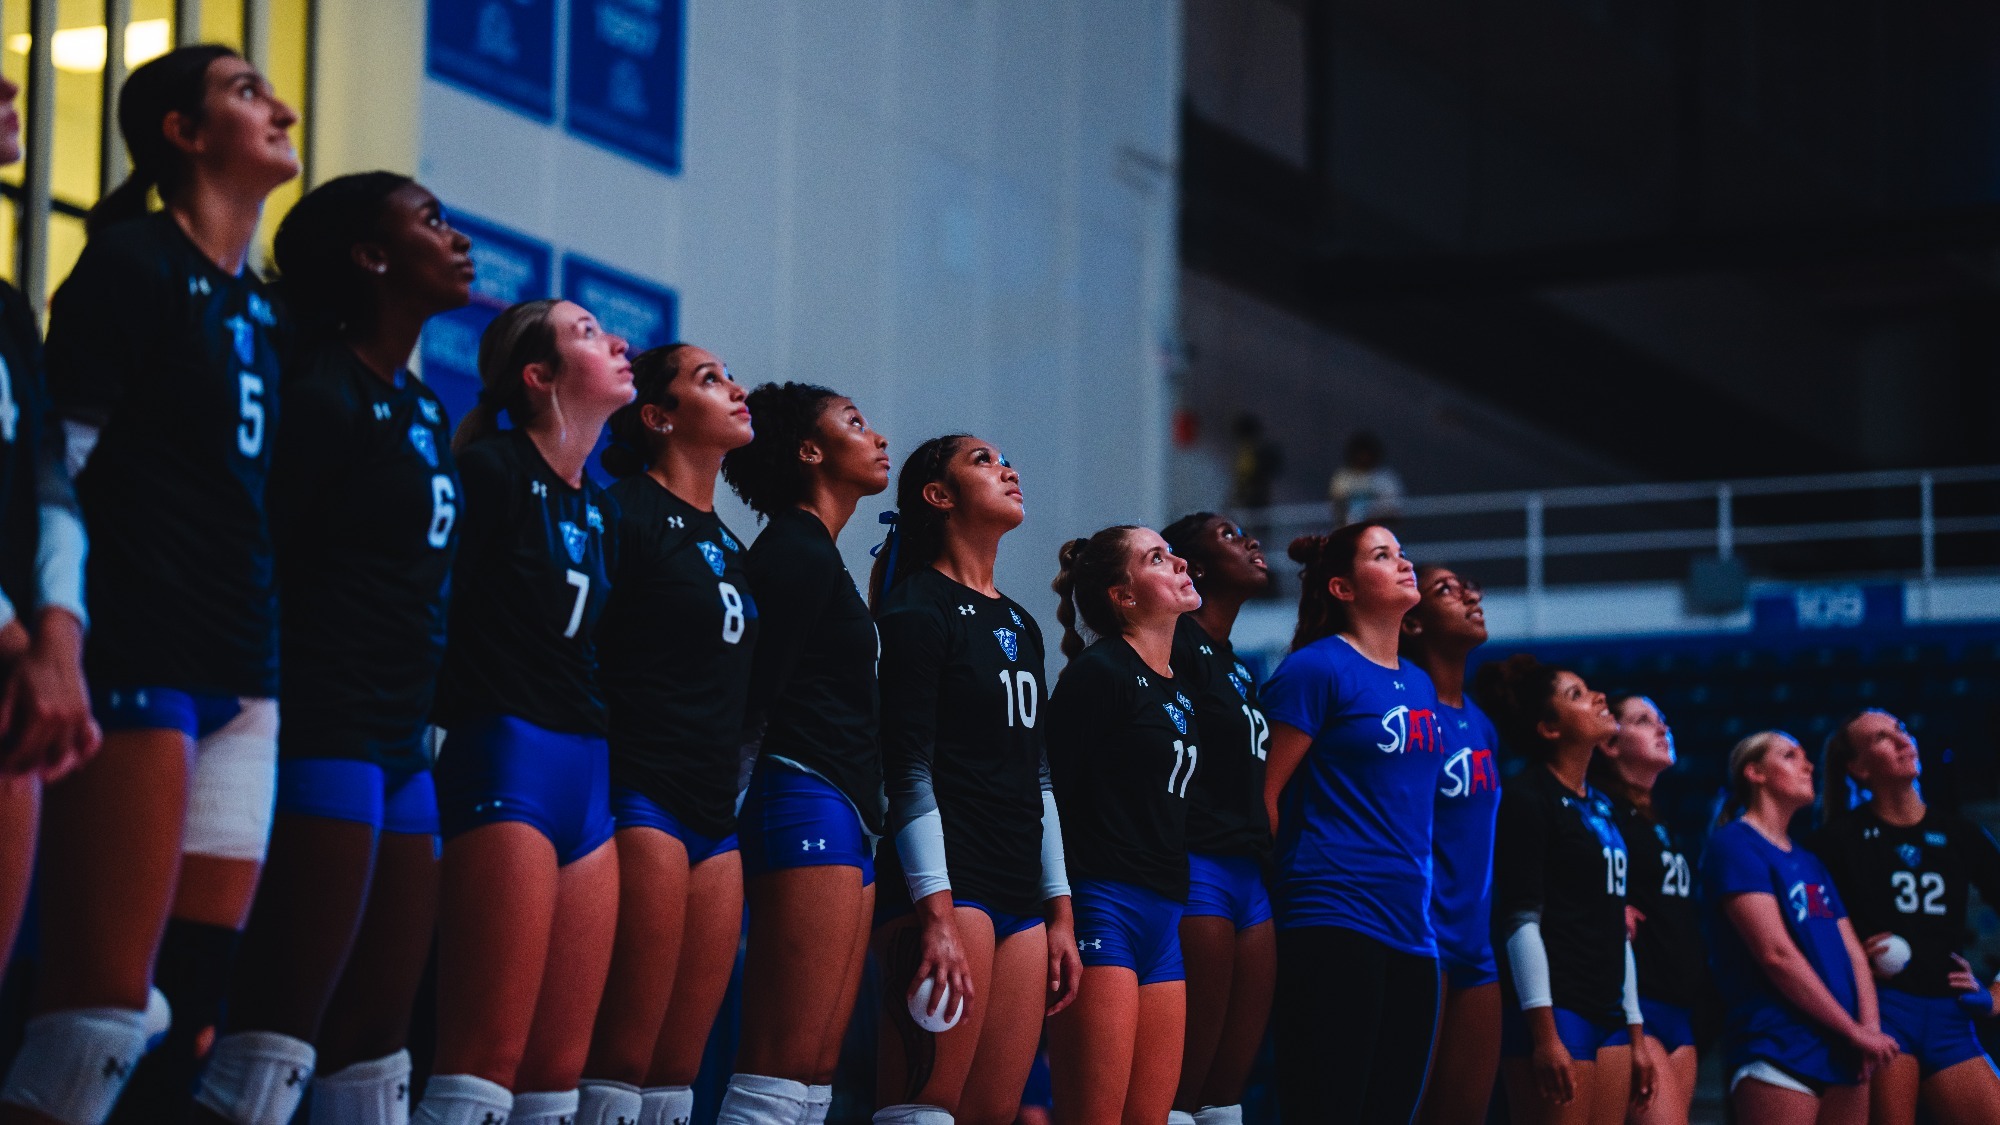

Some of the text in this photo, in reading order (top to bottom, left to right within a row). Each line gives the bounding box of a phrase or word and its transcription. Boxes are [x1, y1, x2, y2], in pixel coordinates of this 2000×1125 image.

[237, 370, 265, 458] 5
[427, 474, 455, 548] 6
[564, 568, 590, 639] 7
[718, 582, 745, 644] 8
[999, 669, 1038, 729] 10
[1242, 704, 1269, 761] 12
[1168, 740, 1197, 798] 11
[1440, 747, 1496, 797] STAT
[1602, 847, 1627, 897] 19
[1661, 850, 1691, 897] 20
[1891, 871, 1947, 915] 32
